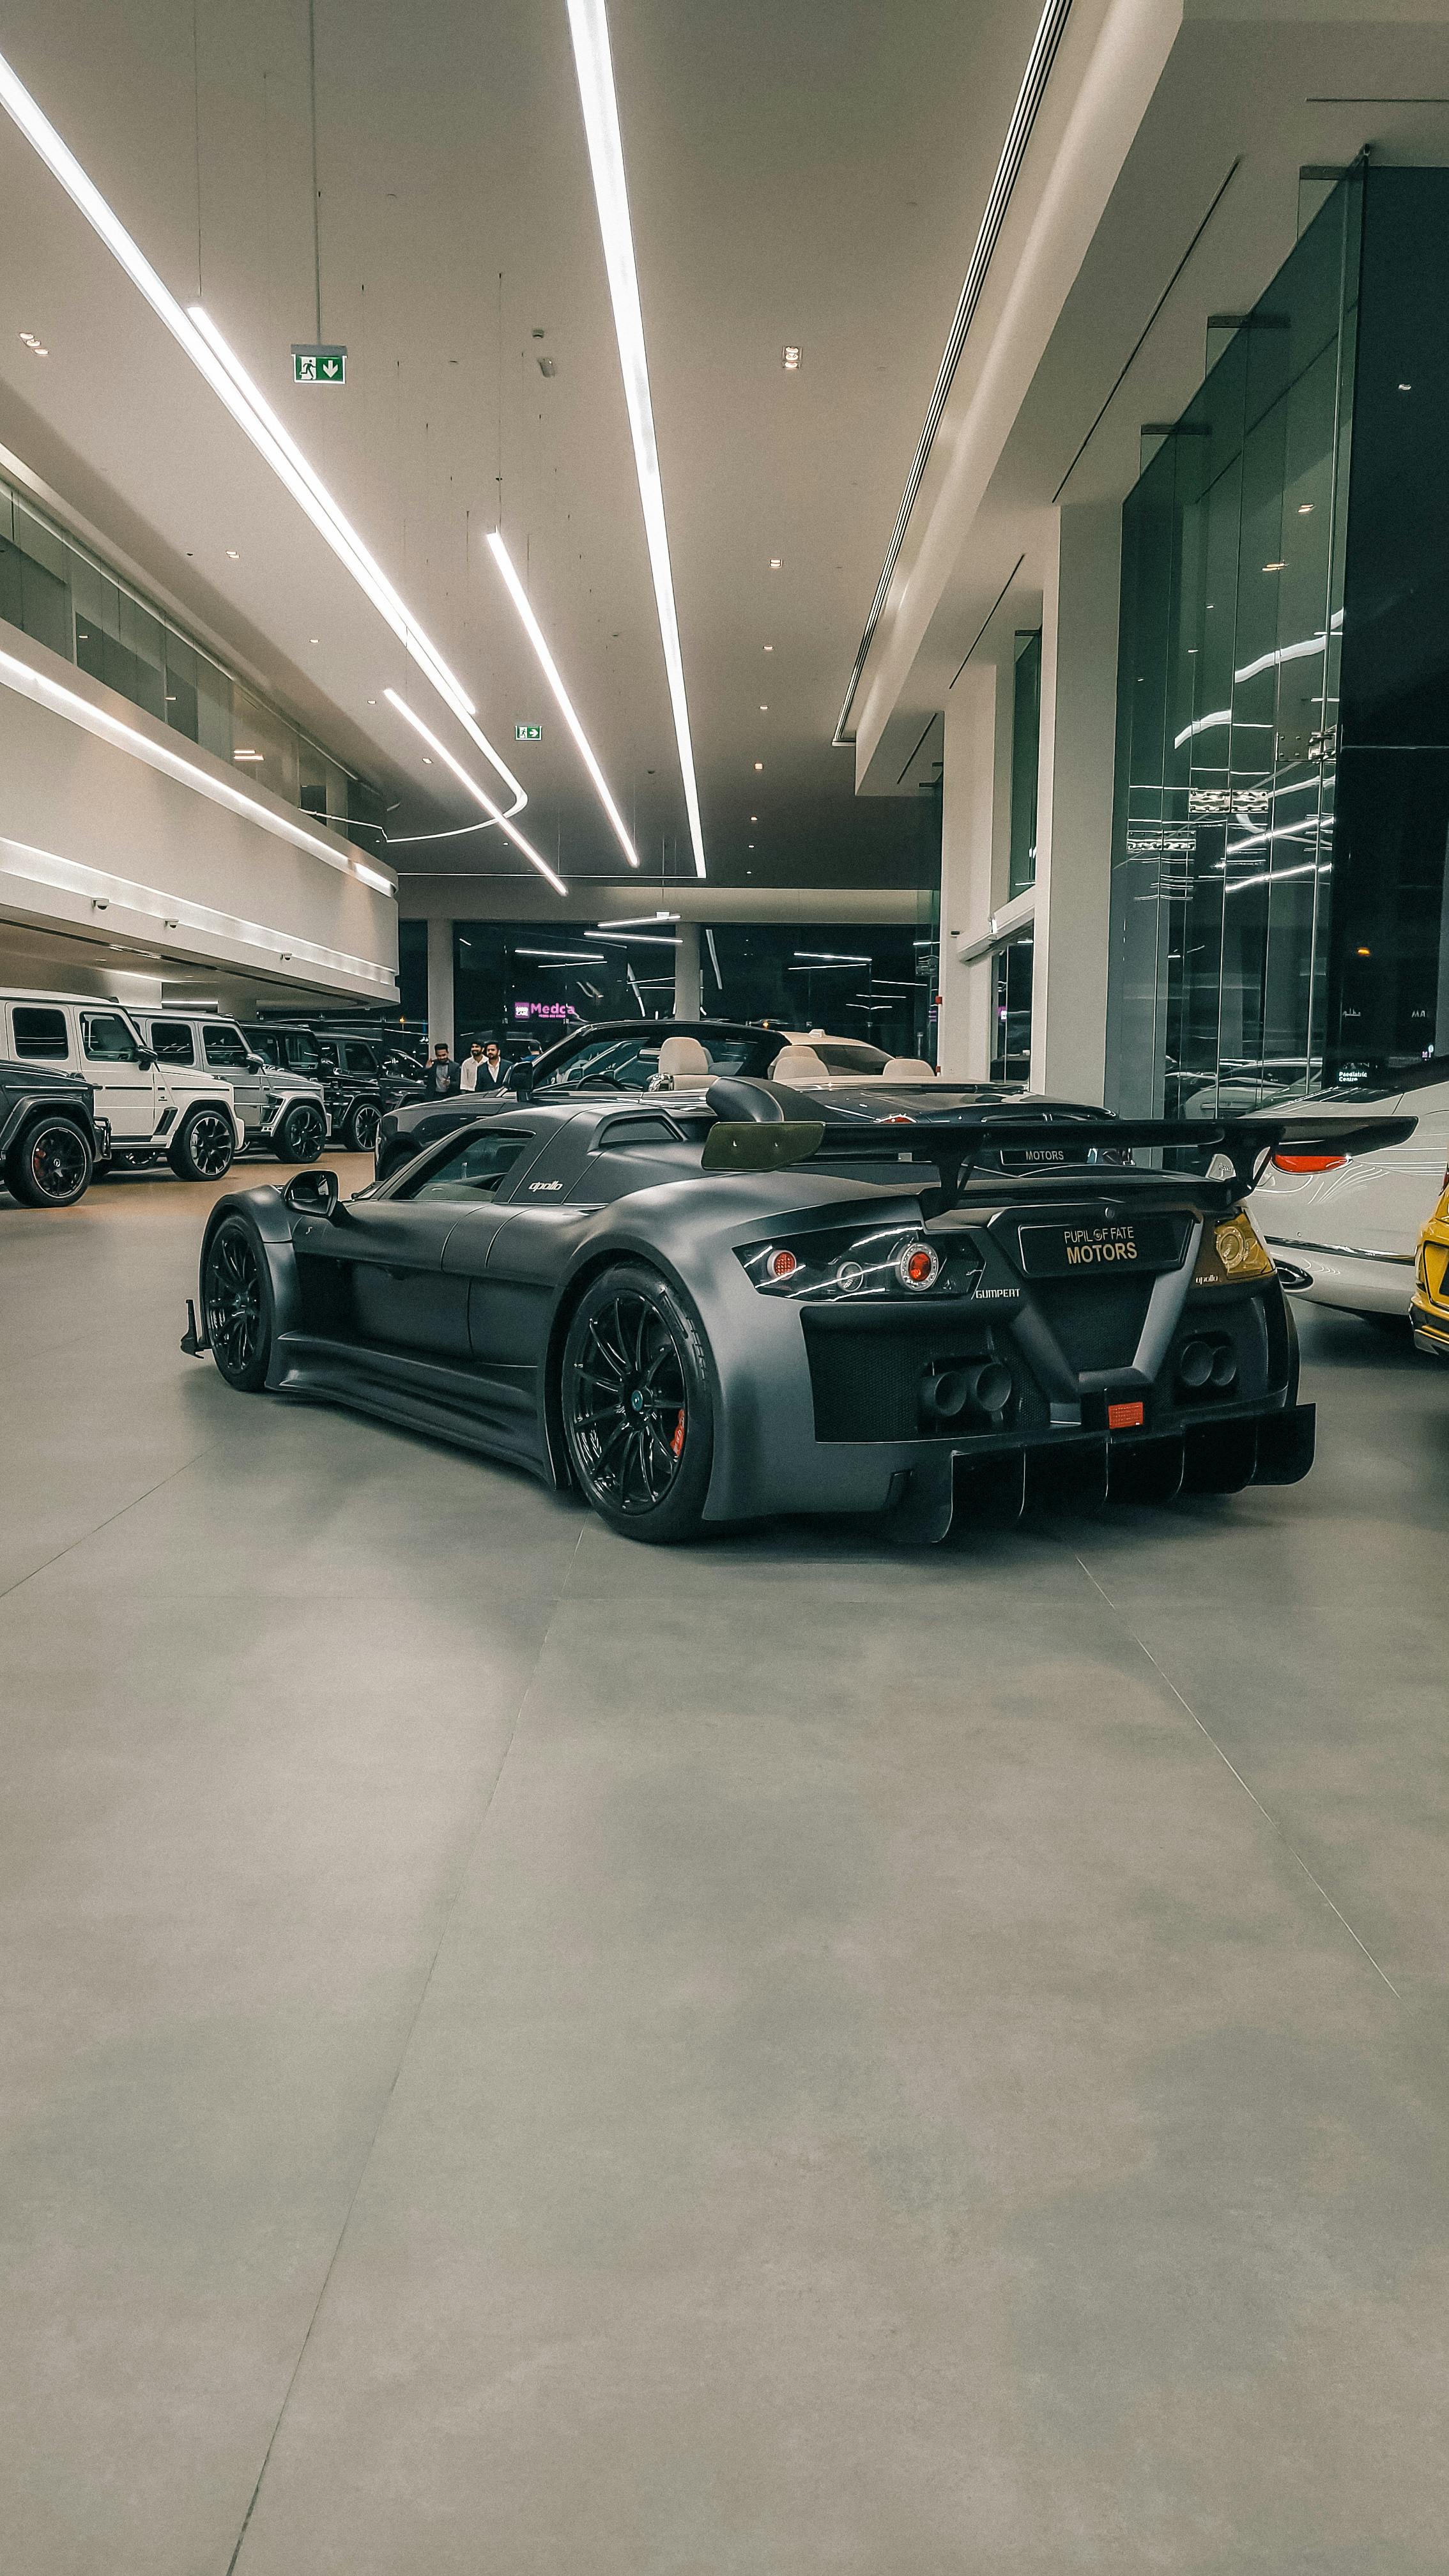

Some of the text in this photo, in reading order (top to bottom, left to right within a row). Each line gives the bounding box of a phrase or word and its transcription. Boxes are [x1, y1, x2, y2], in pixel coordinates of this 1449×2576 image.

[1025, 1151, 1064, 1160] MOTORS
[528, 1181, 563, 1192] apollo
[1064, 1226, 1135, 1244] PUPIL OF FATE
[1066, 1242, 1137, 1264] MOTORS
[976, 1289, 1020, 1299] GUMPERT
